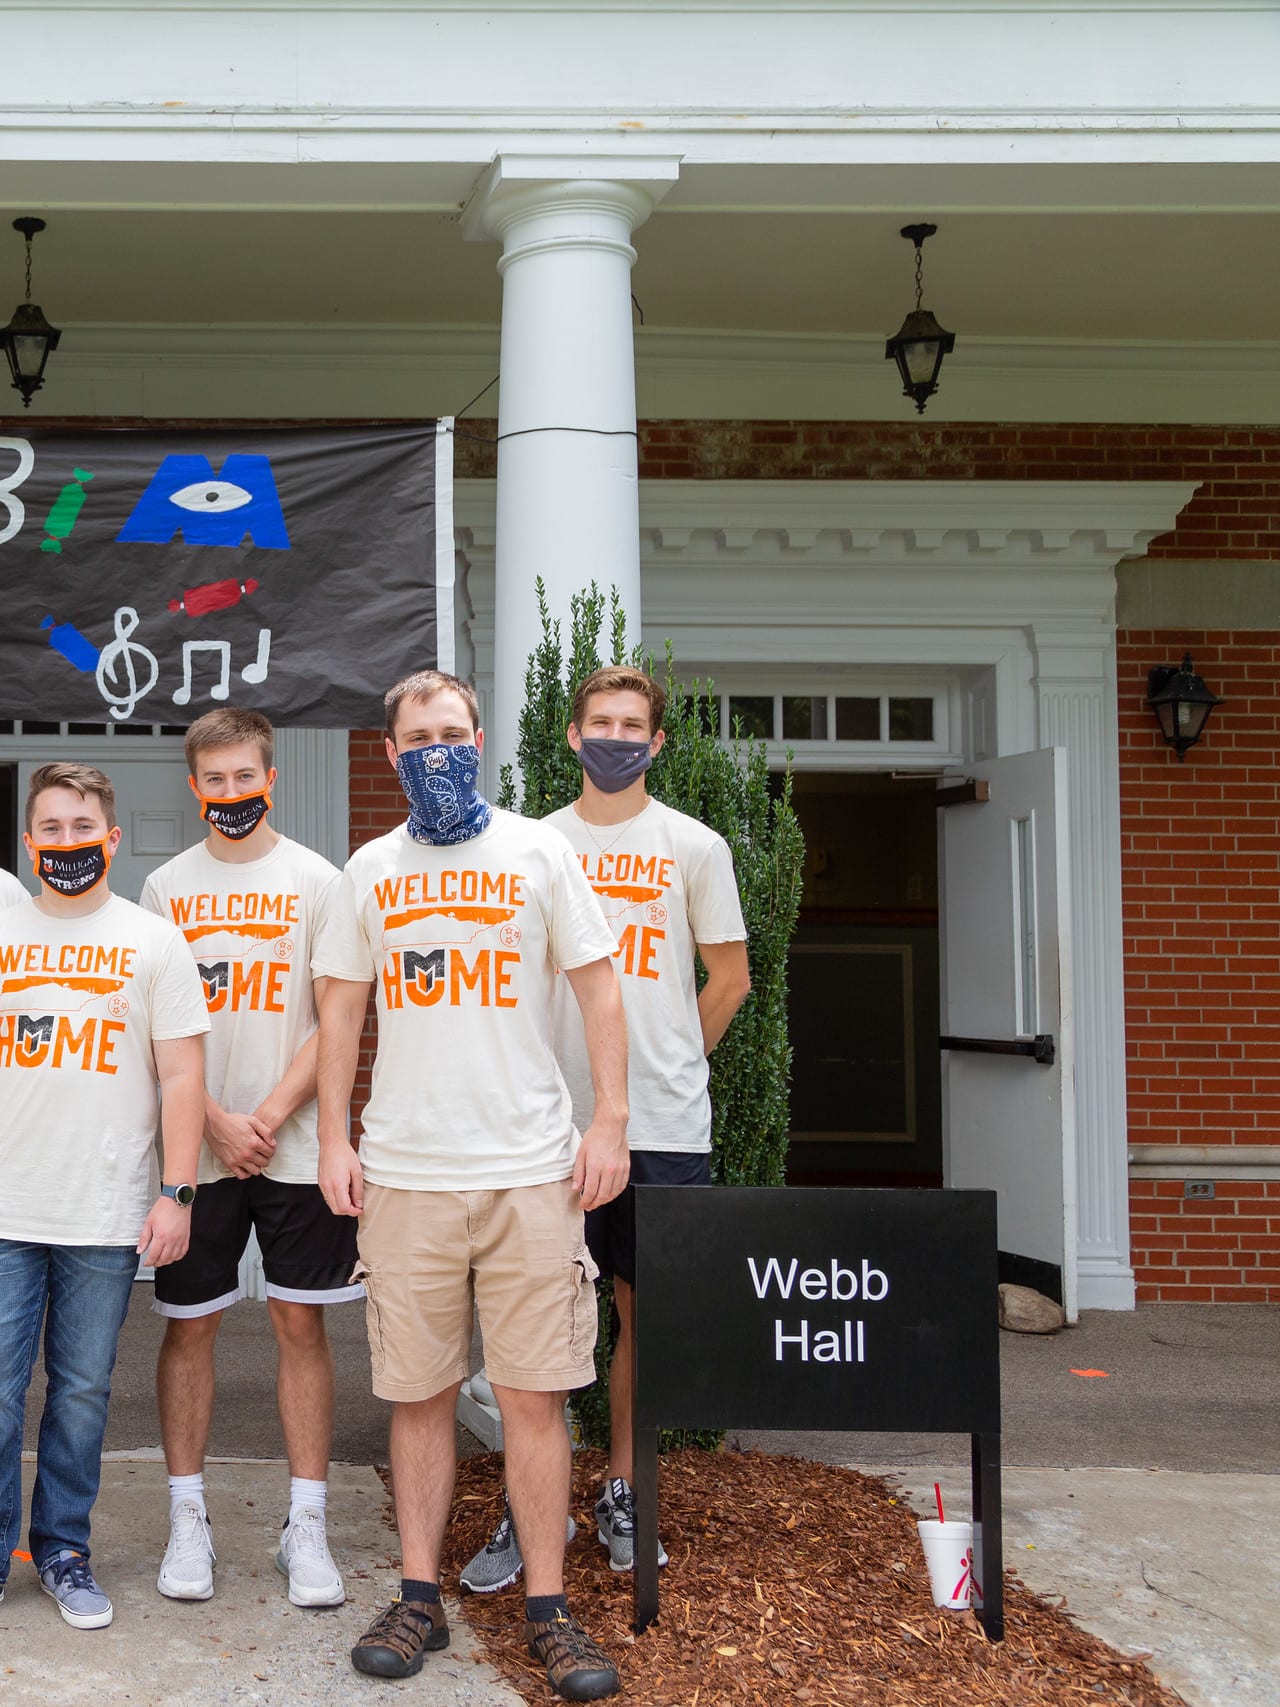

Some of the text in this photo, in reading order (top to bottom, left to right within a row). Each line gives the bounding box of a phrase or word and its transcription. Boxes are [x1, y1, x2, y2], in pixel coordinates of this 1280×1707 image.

[48, 872, 96, 890] STRONG
[53, 855, 99, 872] MILLIGAN
[577, 853, 675, 888] LCOME
[170, 892, 300, 926] WELCOME
[373, 870, 526, 911] WELCOME
[612, 924, 666, 981] ME
[747, 1257, 890, 1301] Webb
[774, 1319, 865, 1362] Hall
